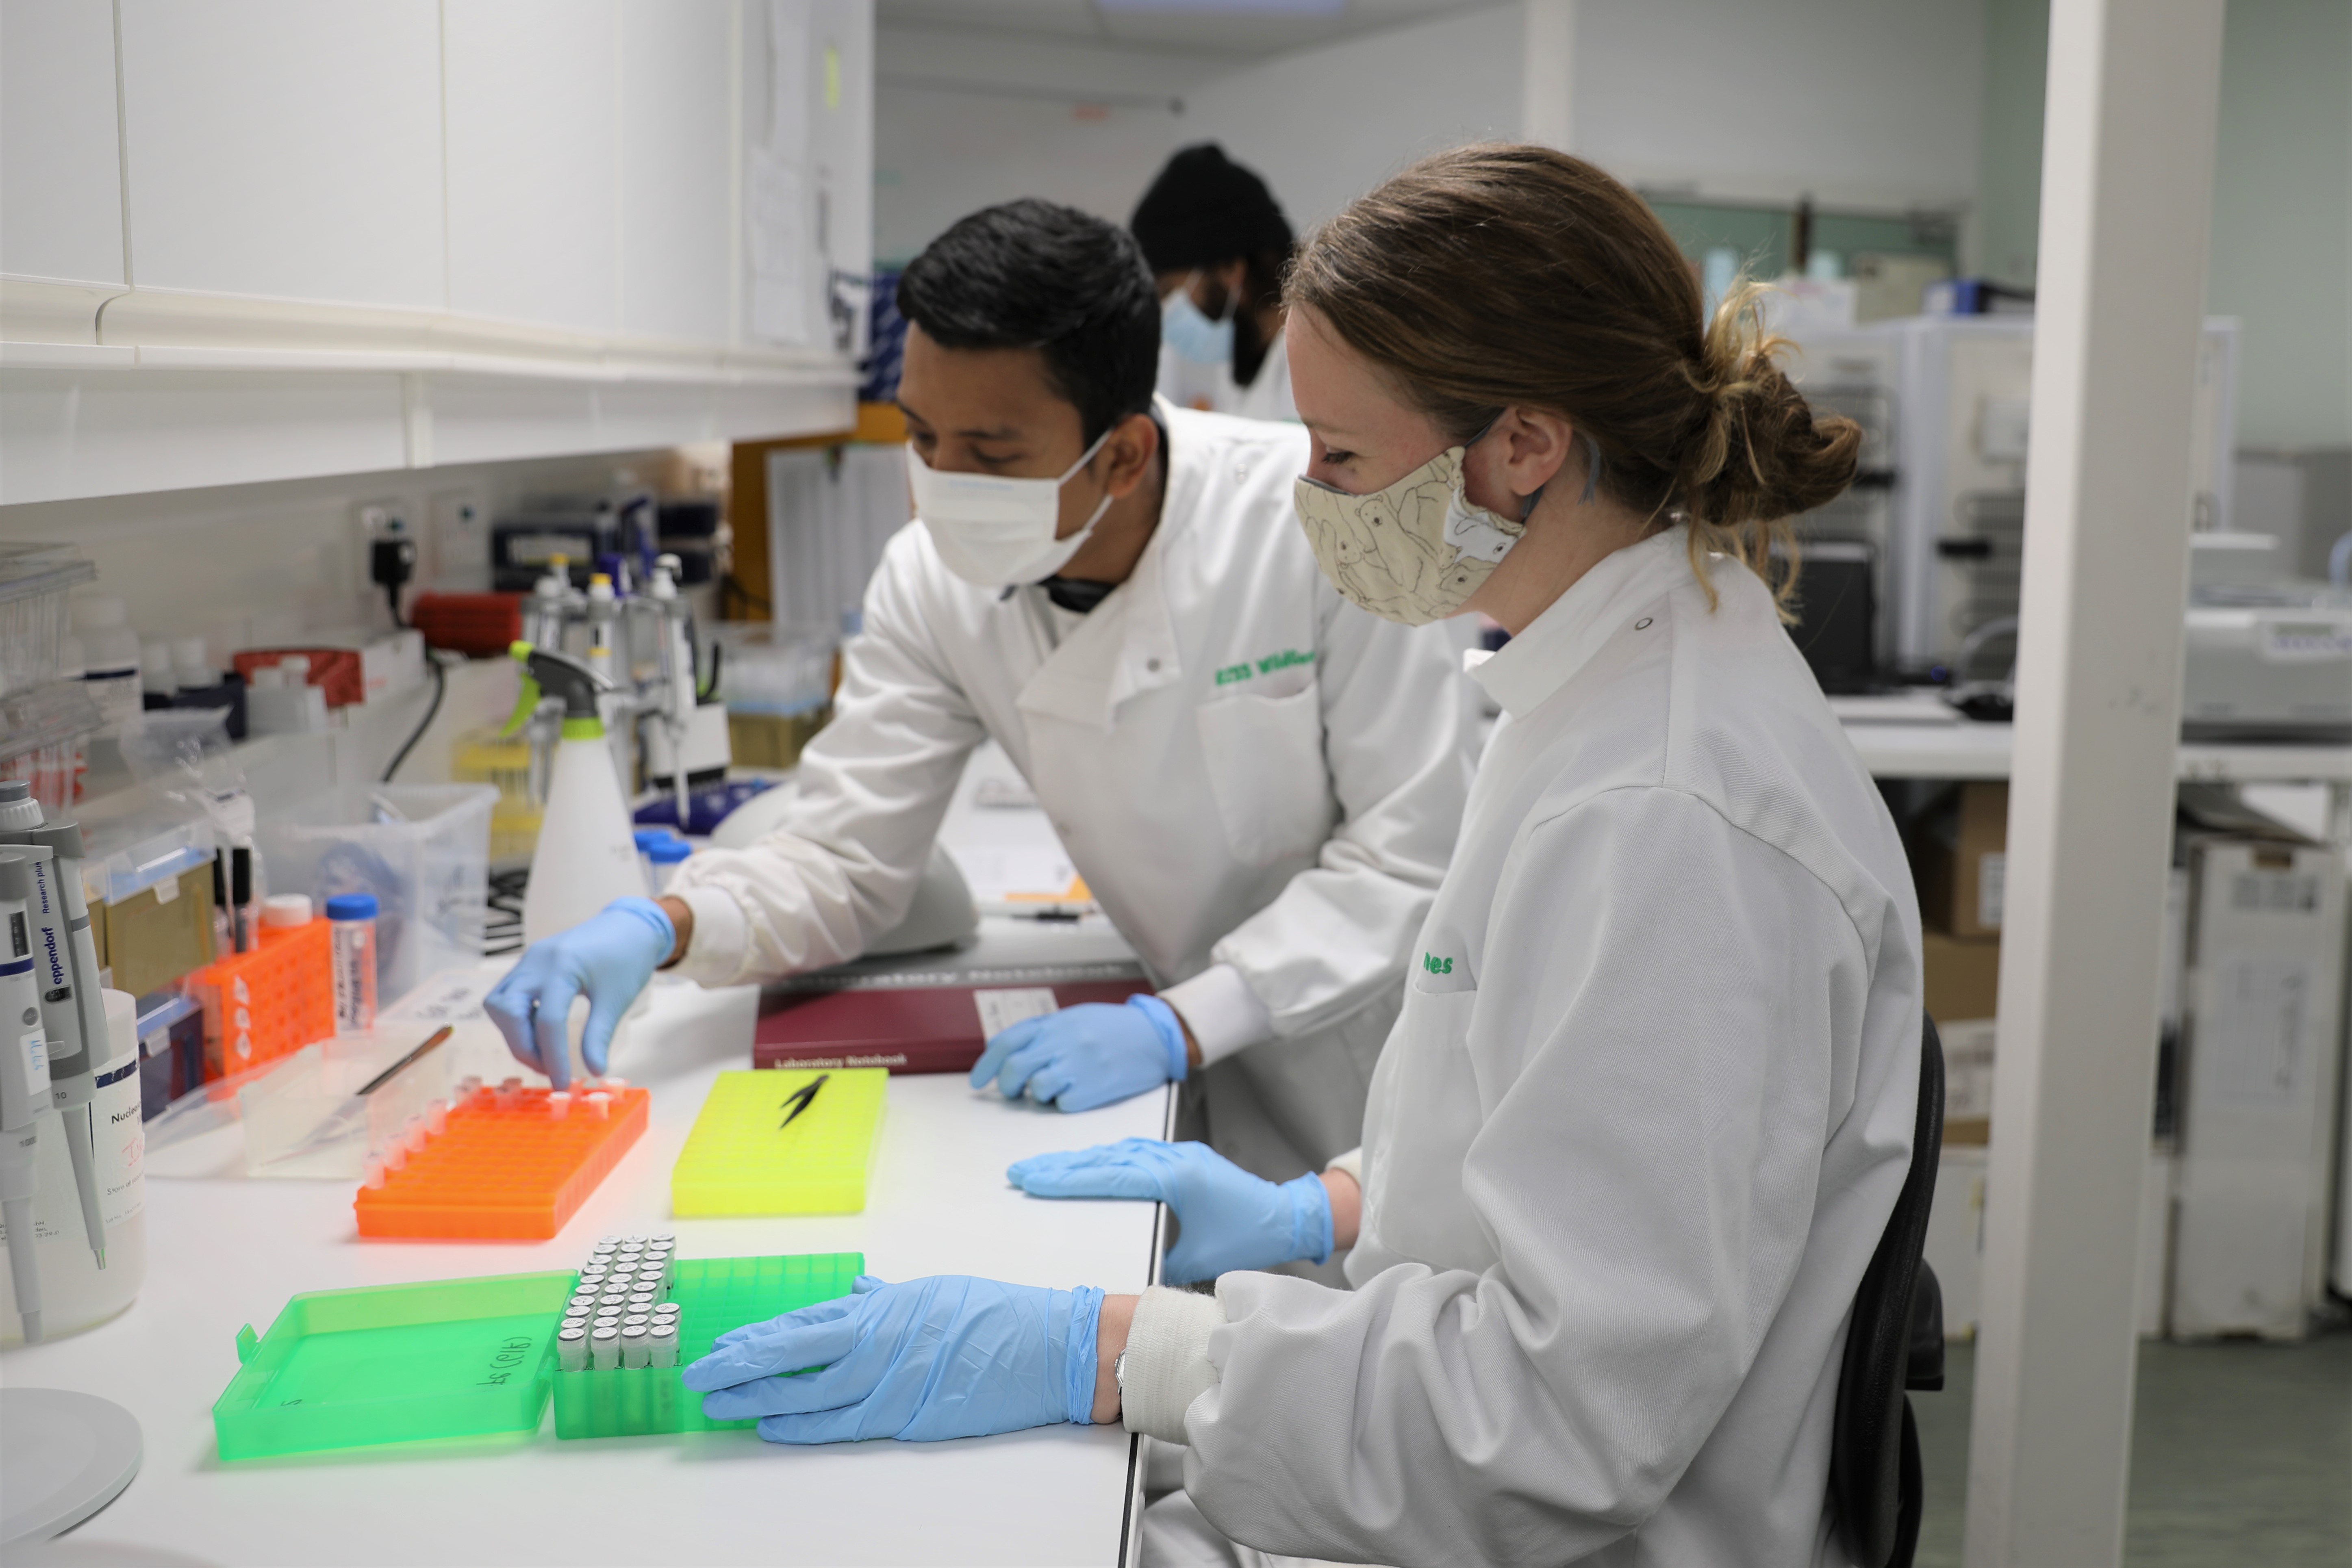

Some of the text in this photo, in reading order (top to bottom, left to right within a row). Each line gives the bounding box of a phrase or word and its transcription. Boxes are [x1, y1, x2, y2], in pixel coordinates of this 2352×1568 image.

[35, 861, 50, 914] Research plus
[41, 927, 64, 985] eppendorf
[774, 1052, 908, 1068] Laboratory Notebook
